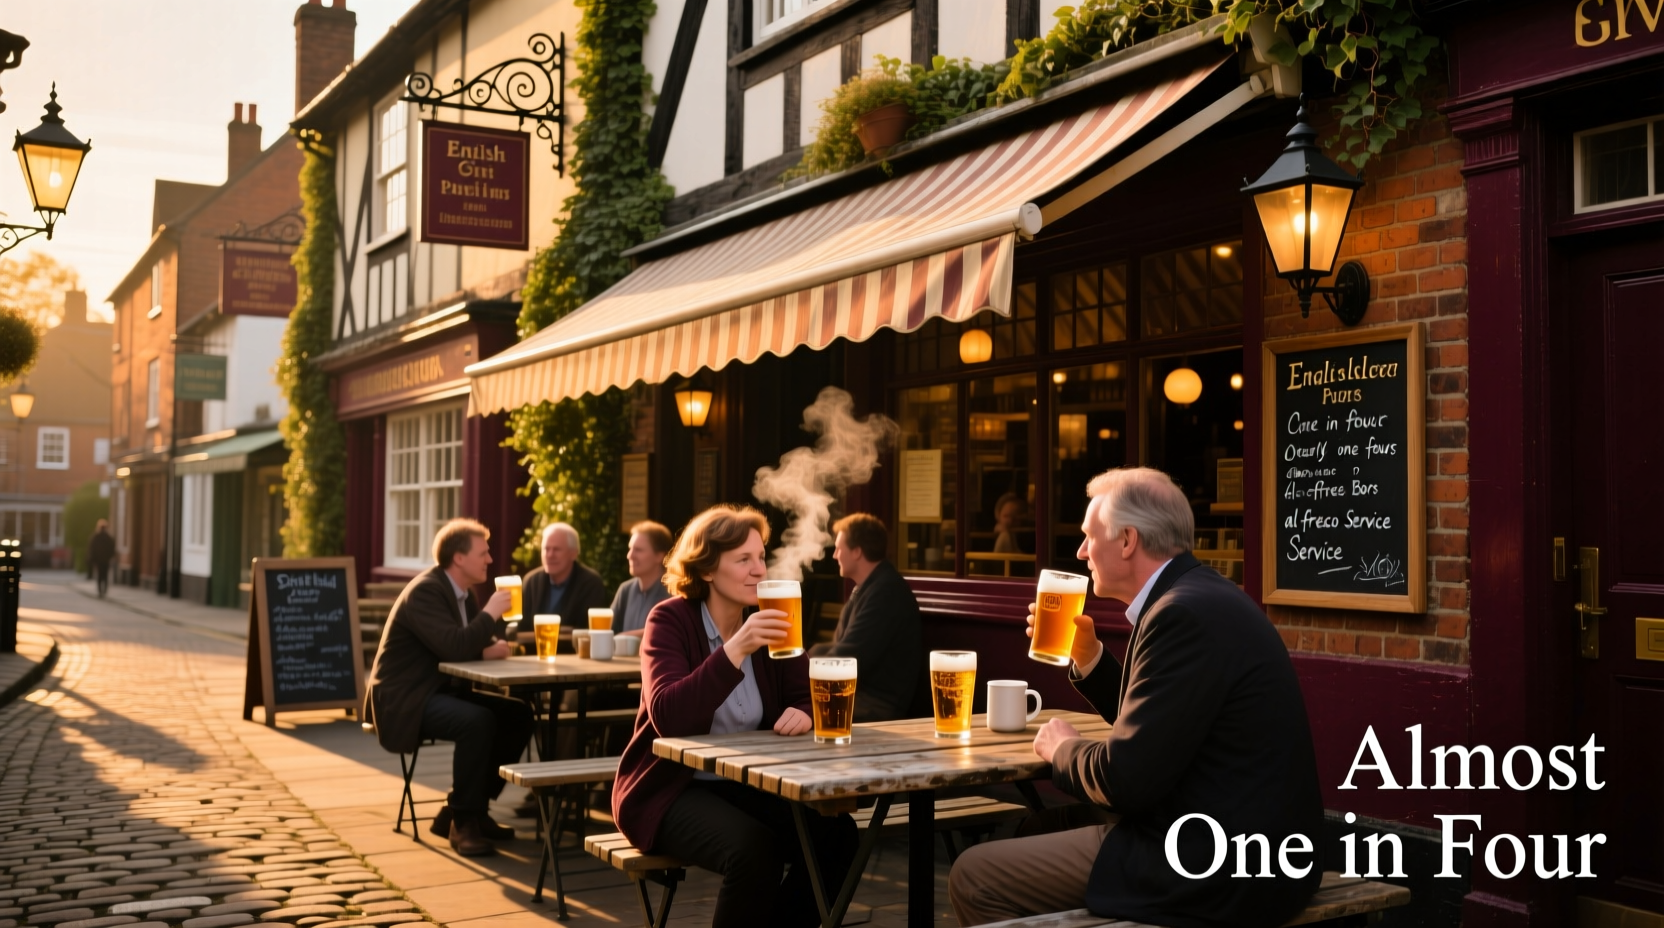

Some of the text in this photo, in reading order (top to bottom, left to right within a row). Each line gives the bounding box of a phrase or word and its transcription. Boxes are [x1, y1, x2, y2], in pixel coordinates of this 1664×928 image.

[1326, 415, 1338, 431] in
[1337, 445, 1359, 456] one
[1284, 508, 1299, 529] al
[1344, 509, 1392, 530] Service
[1287, 534, 1343, 561] Service
